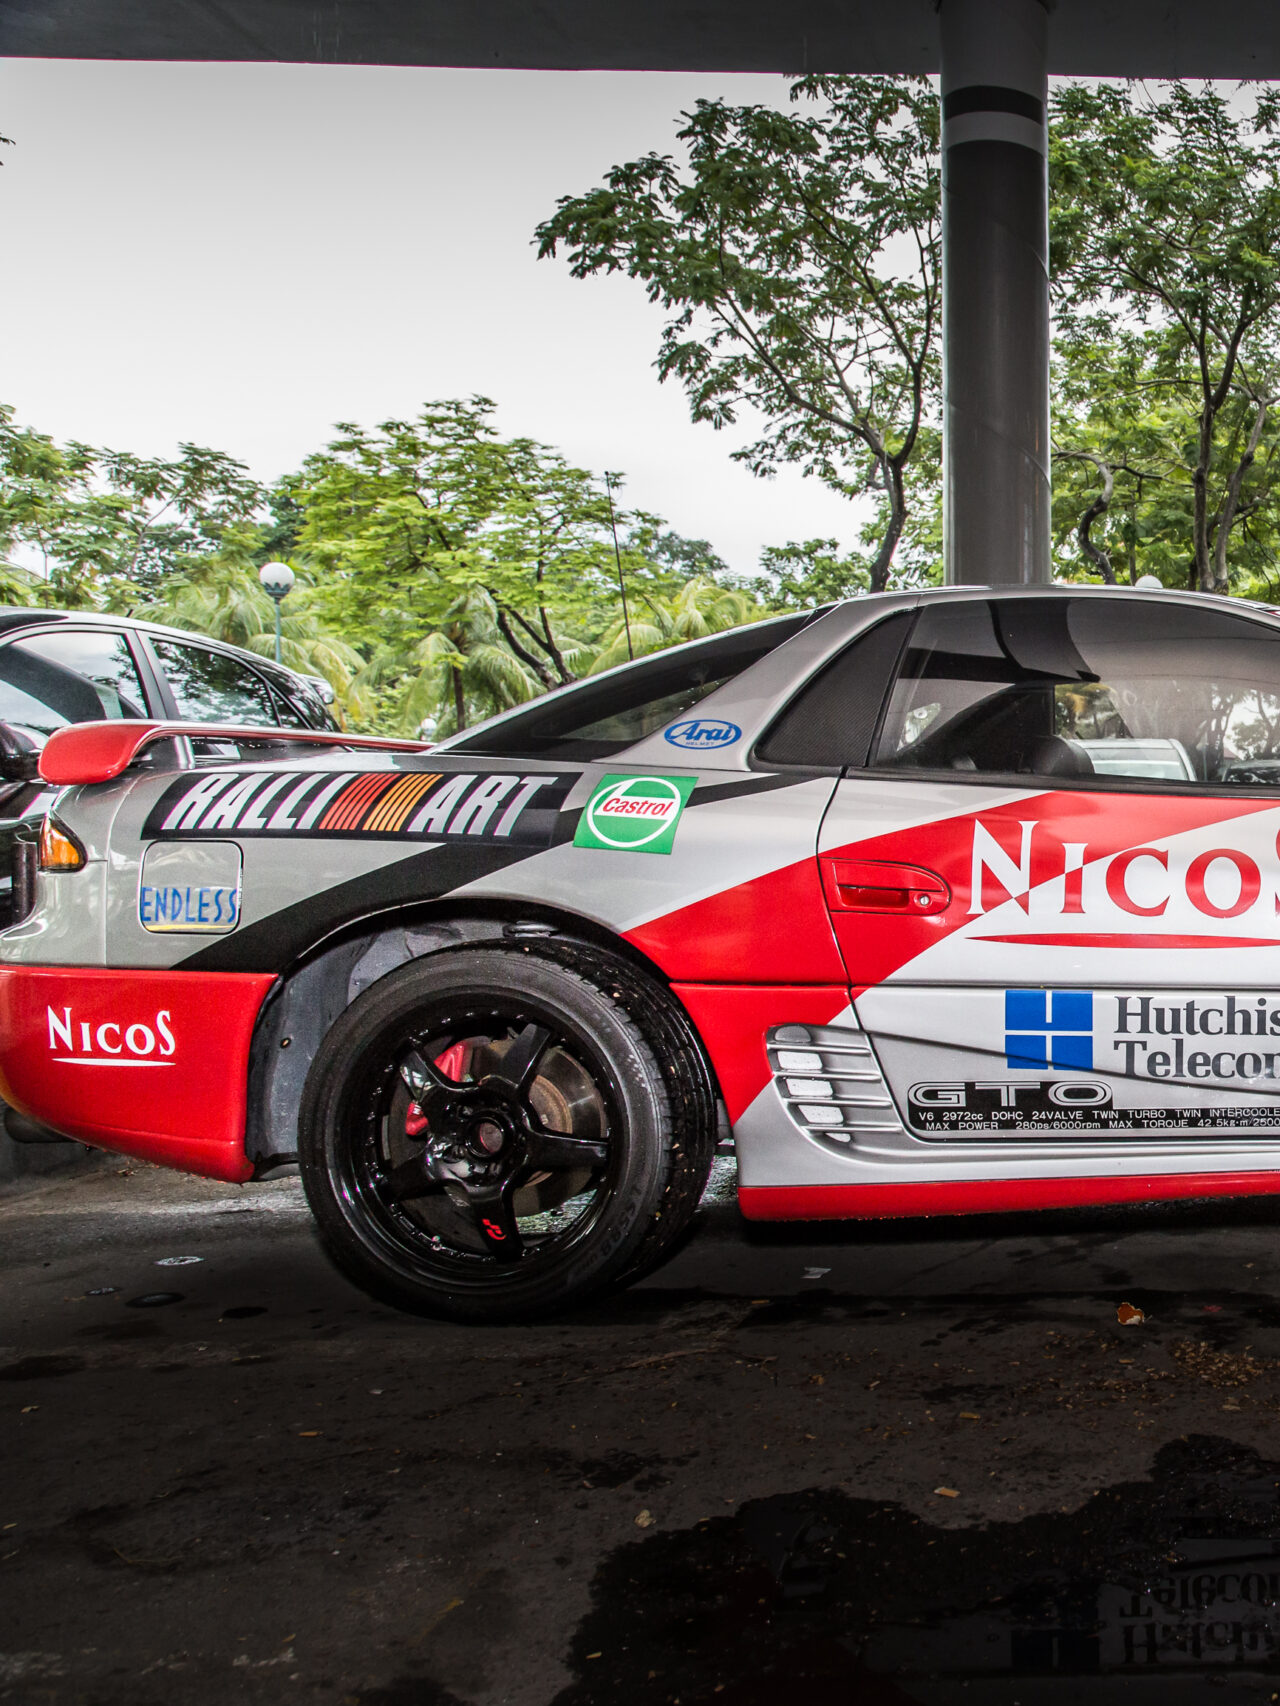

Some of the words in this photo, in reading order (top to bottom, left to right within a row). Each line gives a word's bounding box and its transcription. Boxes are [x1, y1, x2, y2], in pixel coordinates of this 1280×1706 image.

[668, 722, 735, 741] Arai
[602, 798, 674, 816] Castrol
[141, 886, 239, 924] ENDLESS
[907, 1081, 1113, 1108] GTO
[918, 1111, 935, 1121] V6
[942, 1111, 984, 1121] 2972cc
[991, 1111, 1024, 1121] DOHC
[1031, 1110, 1084, 1120] 24VALVE
[1092, 1110, 1119, 1119] TWIN
[1127, 1109, 1166, 1119] TURBO
[1175, 1109, 1201, 1118] TWIN
[926, 1121, 950, 1131] MAX
[958, 1121, 999, 1131] POWER
[1108, 1119, 1133, 1129] MAX
[1143, 1119, 1189, 1129] TORQUE
